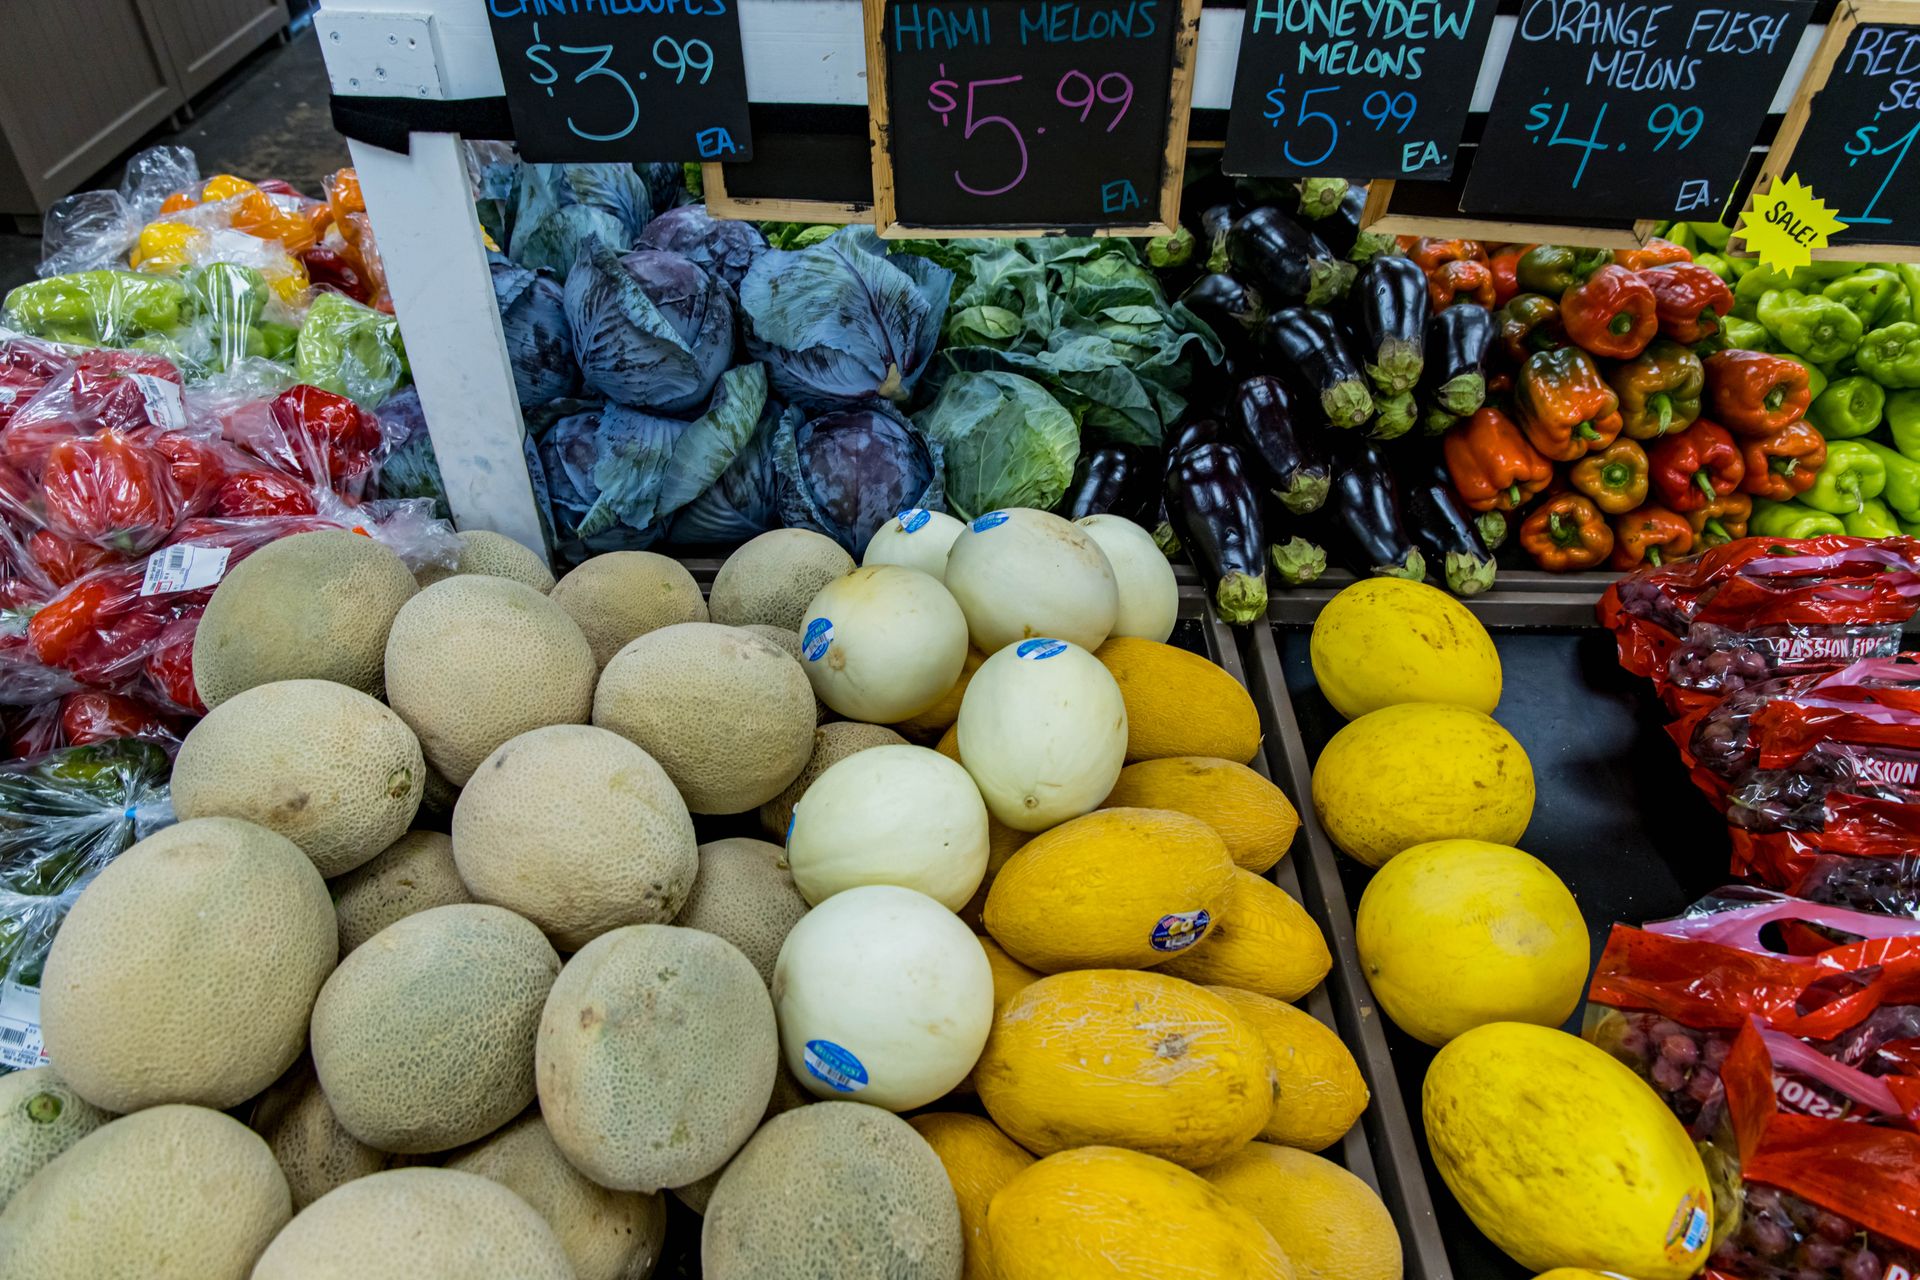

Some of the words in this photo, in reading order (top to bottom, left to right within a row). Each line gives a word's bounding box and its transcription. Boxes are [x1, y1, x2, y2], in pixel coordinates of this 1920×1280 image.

[894, 4, 991, 51] HAMI
[1019, 2, 1157, 46] MELONS
[1253, 0, 1476, 40] HONEYDEW
[1521, 0, 1673, 48] ORANGE
[1686, 9, 1790, 54] FLESH
[1298, 40, 1426, 80] MELONS
[1586, 50, 1702, 92] MELONS
[525, 22, 714, 142] $3.99
[1879, 79, 1920, 112] SE
[1263, 73, 1418, 168] $5.99
[695, 127, 745, 158] EA.
[1401, 140, 1448, 173] EA.
[1101, 180, 1149, 214] EA.
[1675, 180, 1720, 212] EA.
[1764, 200, 1819, 248] SALE!
[1779, 638, 1849, 658] PASSION
